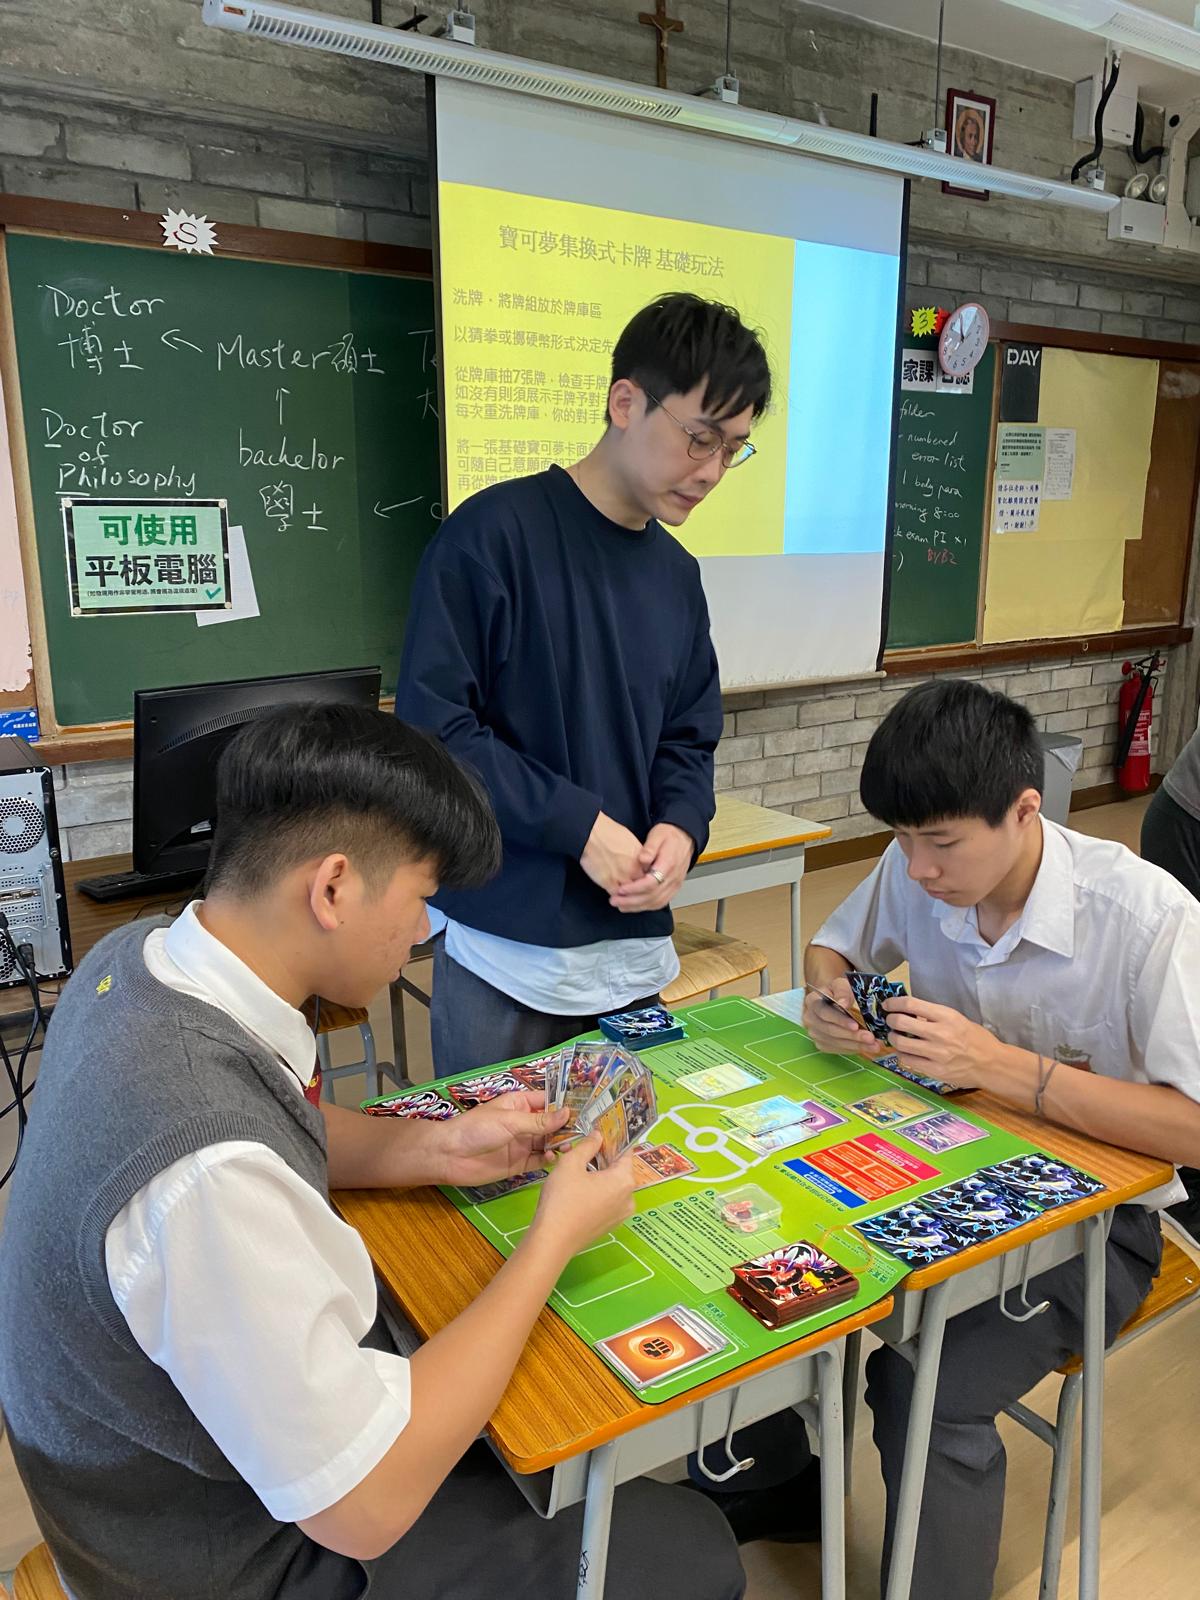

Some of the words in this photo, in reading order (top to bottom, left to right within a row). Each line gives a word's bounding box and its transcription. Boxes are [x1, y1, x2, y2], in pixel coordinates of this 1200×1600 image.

[173, 221, 198, 245] S
[498, 223, 652, 270] 寶可夢集換式卡牌
[655, 247, 725, 278] 基礎玩法
[38, 284, 166, 318] Doctor
[918, 312, 929, 330] 3
[57, 320, 145, 376] 博士
[217, 334, 331, 372] Master
[1006, 348, 1040, 367] DAY
[41, 408, 144, 440] Doctor
[78, 441, 110, 465] of
[239, 428, 345, 470] bachelor
[944, 452, 967, 472] list
[57, 464, 196, 496] Philosophy
[259, 480, 329, 533] 學士
[98, 513, 198, 547] 可使用
[84, 553, 218, 588] 平板電腦
